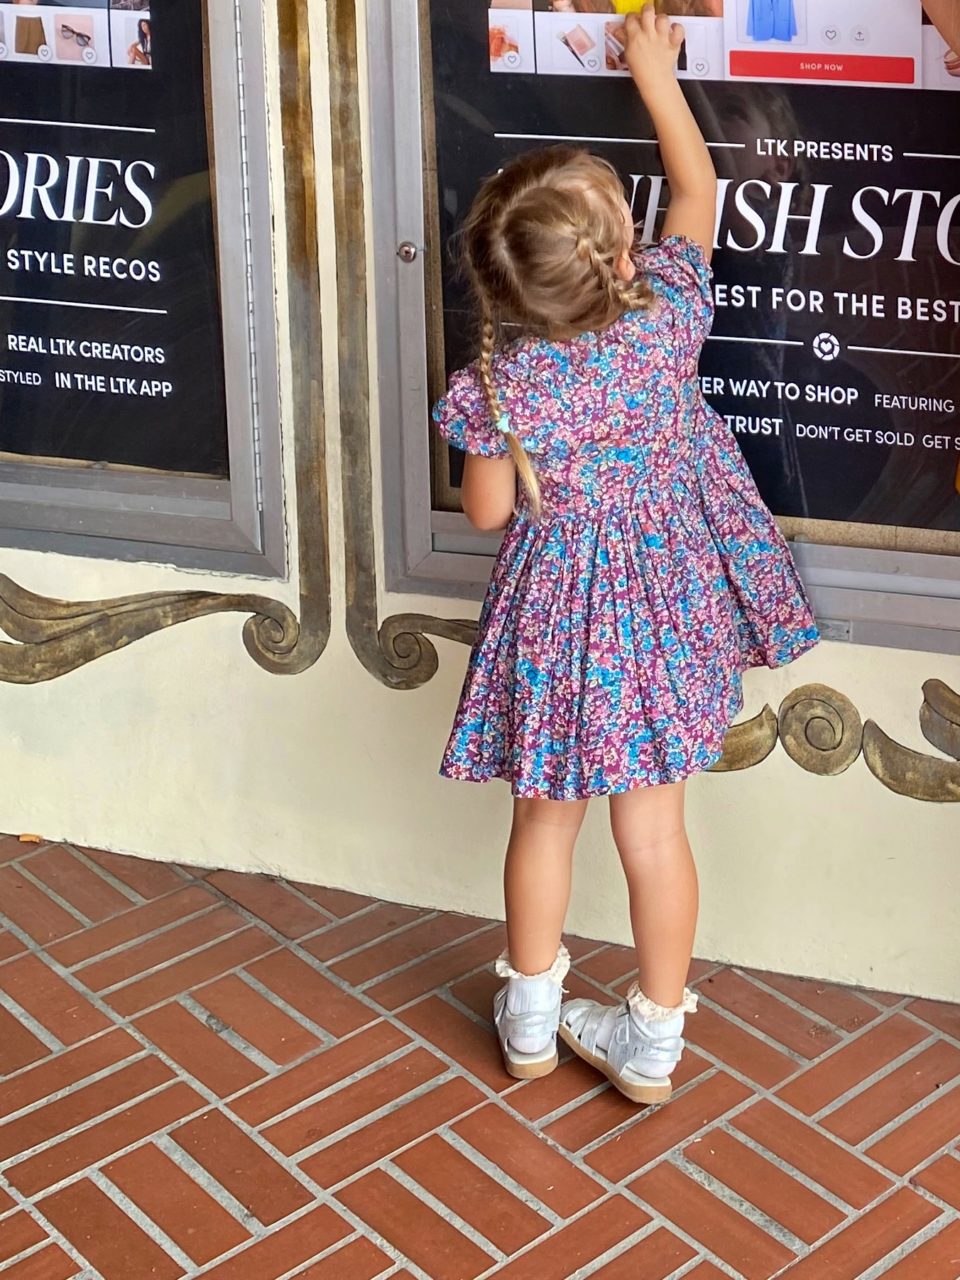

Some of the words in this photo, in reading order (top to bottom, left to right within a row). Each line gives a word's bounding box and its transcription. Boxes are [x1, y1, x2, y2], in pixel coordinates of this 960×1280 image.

[800, 62, 822, 70] SHOP
[824, 63, 844, 72] NOW
[756, 138, 788, 157] LTK
[794, 140, 894, 163] PRESENTS
[7, 248, 75, 275] STYLE
[84, 255, 161, 283] RECOS
[771, 287, 824, 313] FOR
[833, 292, 885, 318] THE
[7, 334, 47, 354] REAL
[50, 338, 77, 356] LTK
[79, 341, 165, 365] CREATORS
[0, 369, 42, 386] STYLED
[55, 371, 71, 390] IN
[74, 373, 106, 393] THE
[110, 376, 137, 395] LTK
[139, 379, 173, 398] APP
[697, 376, 725, 395] ER
[729, 378, 771, 398] WAY
[773, 381, 800, 401] TO
[804, 384, 859, 405] SHOP
[874, 393, 955, 413] FEATURING
[723, 414, 783, 436] TRUST
[796, 423, 841, 440] DON'T
[843, 427, 872, 443] GET
[875, 430, 915, 446] SOLD
[922, 434, 951, 450] GET
